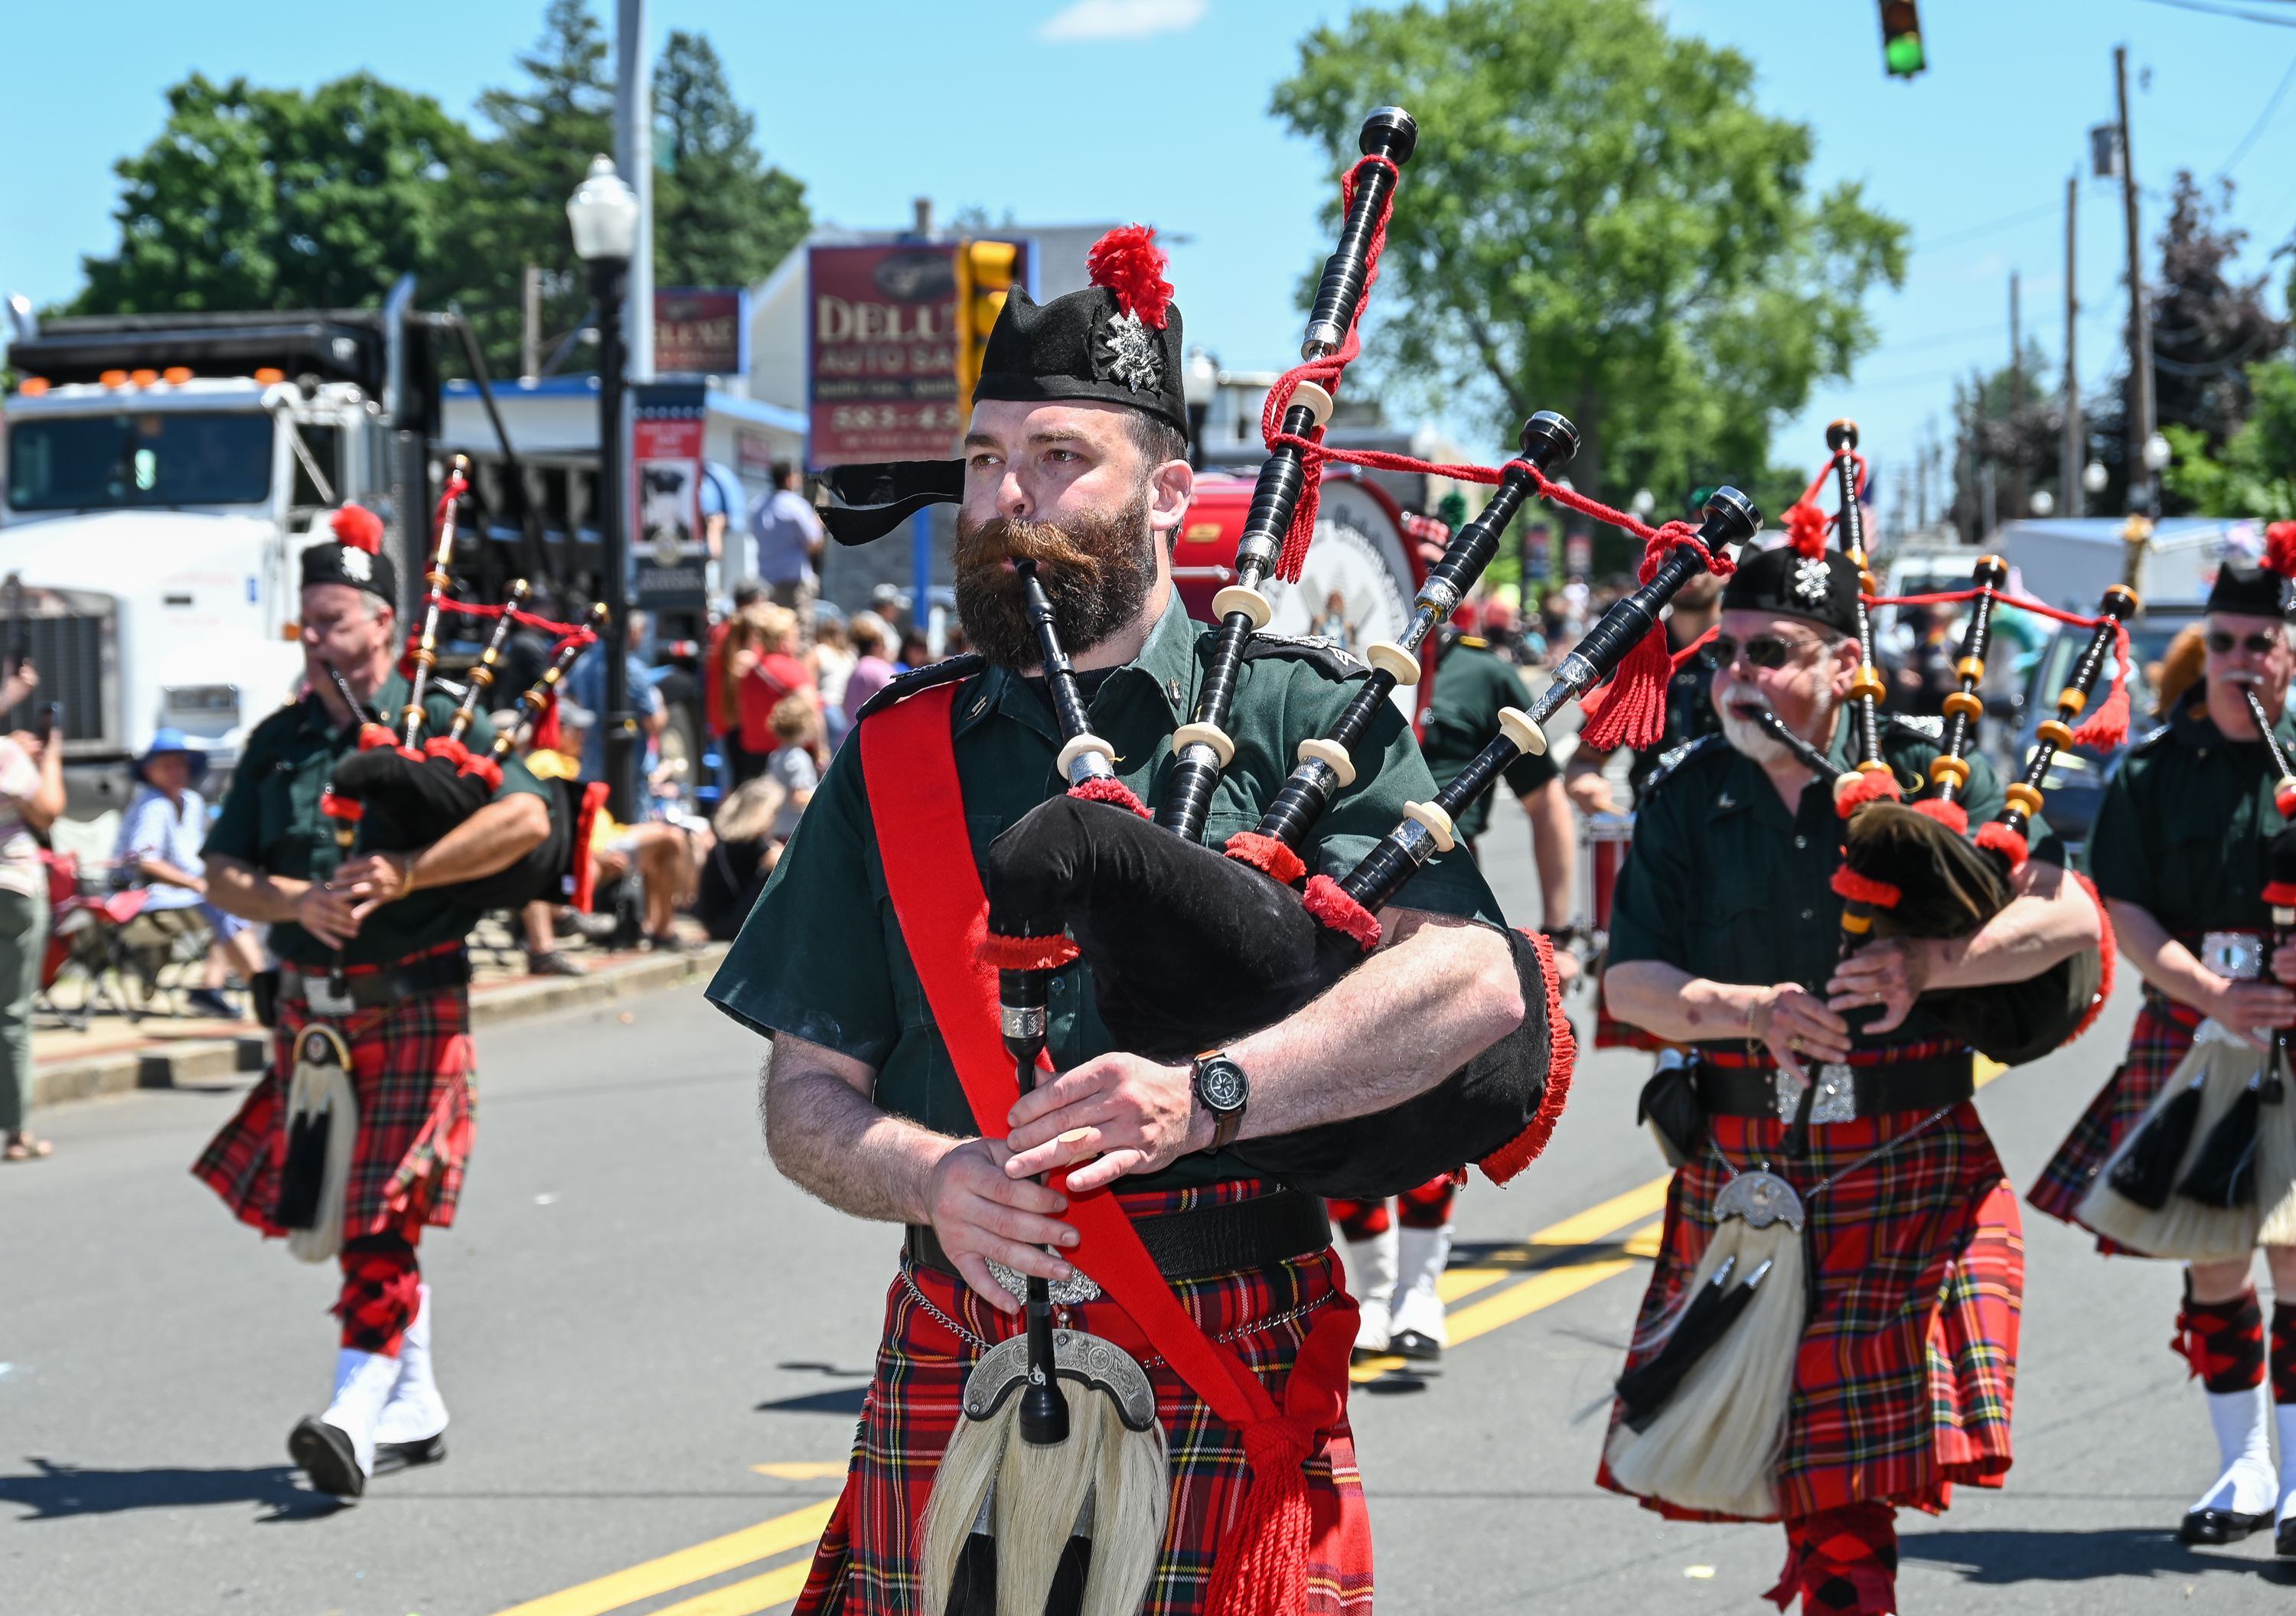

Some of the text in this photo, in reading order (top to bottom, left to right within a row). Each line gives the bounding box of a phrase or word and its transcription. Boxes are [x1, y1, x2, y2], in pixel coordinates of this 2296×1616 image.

[817, 292, 957, 342] DELU
[818, 344, 955, 375] AUTO SA
